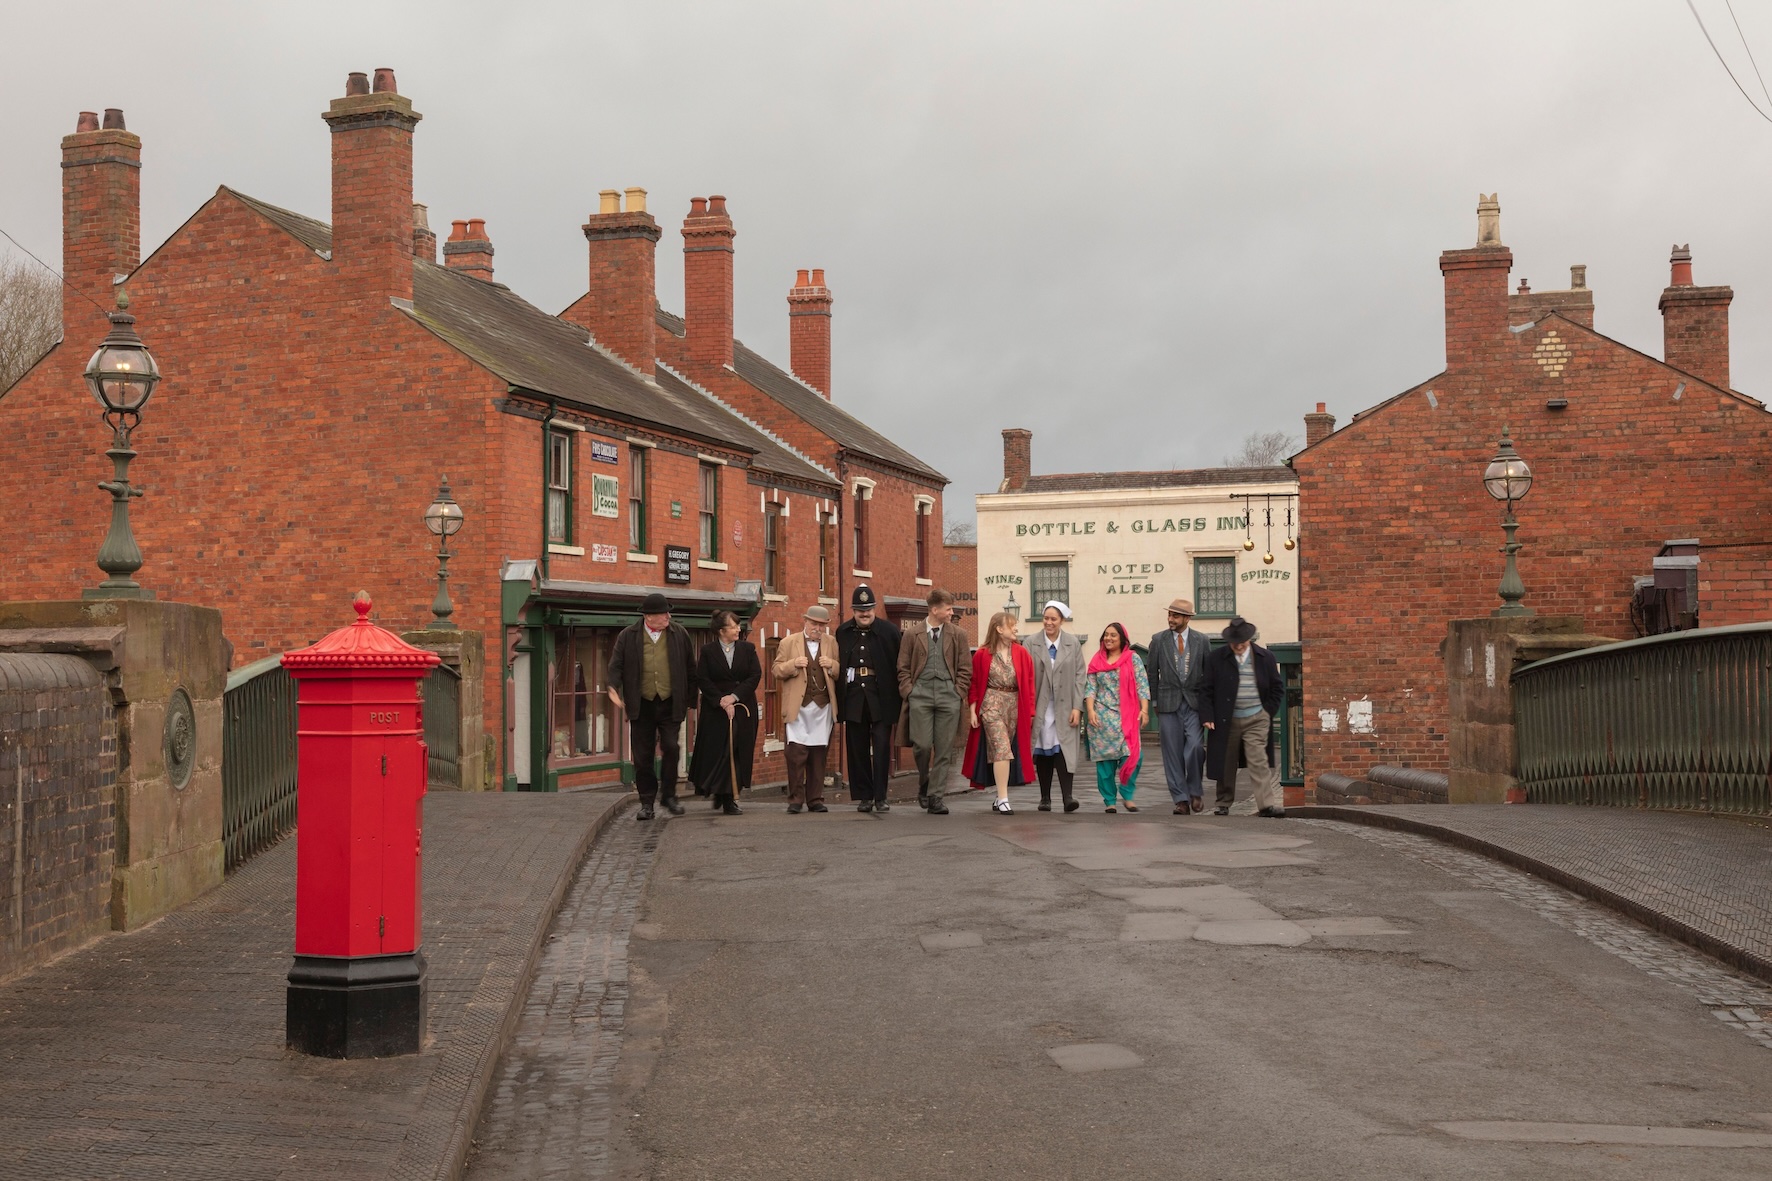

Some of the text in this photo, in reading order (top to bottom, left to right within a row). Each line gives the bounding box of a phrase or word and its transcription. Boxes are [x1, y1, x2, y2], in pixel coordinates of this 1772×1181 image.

[600, 497, 618, 509] COCOA
[1016, 516, 1247, 537] BOTTLE & GLASS INN
[1097, 563, 1165, 574] NOTED
[984, 574, 1023, 586] WINES
[1240, 569, 1291, 583] SPIRITS
[1106, 583, 1154, 595] ALES
[369, 711, 400, 724] POST
